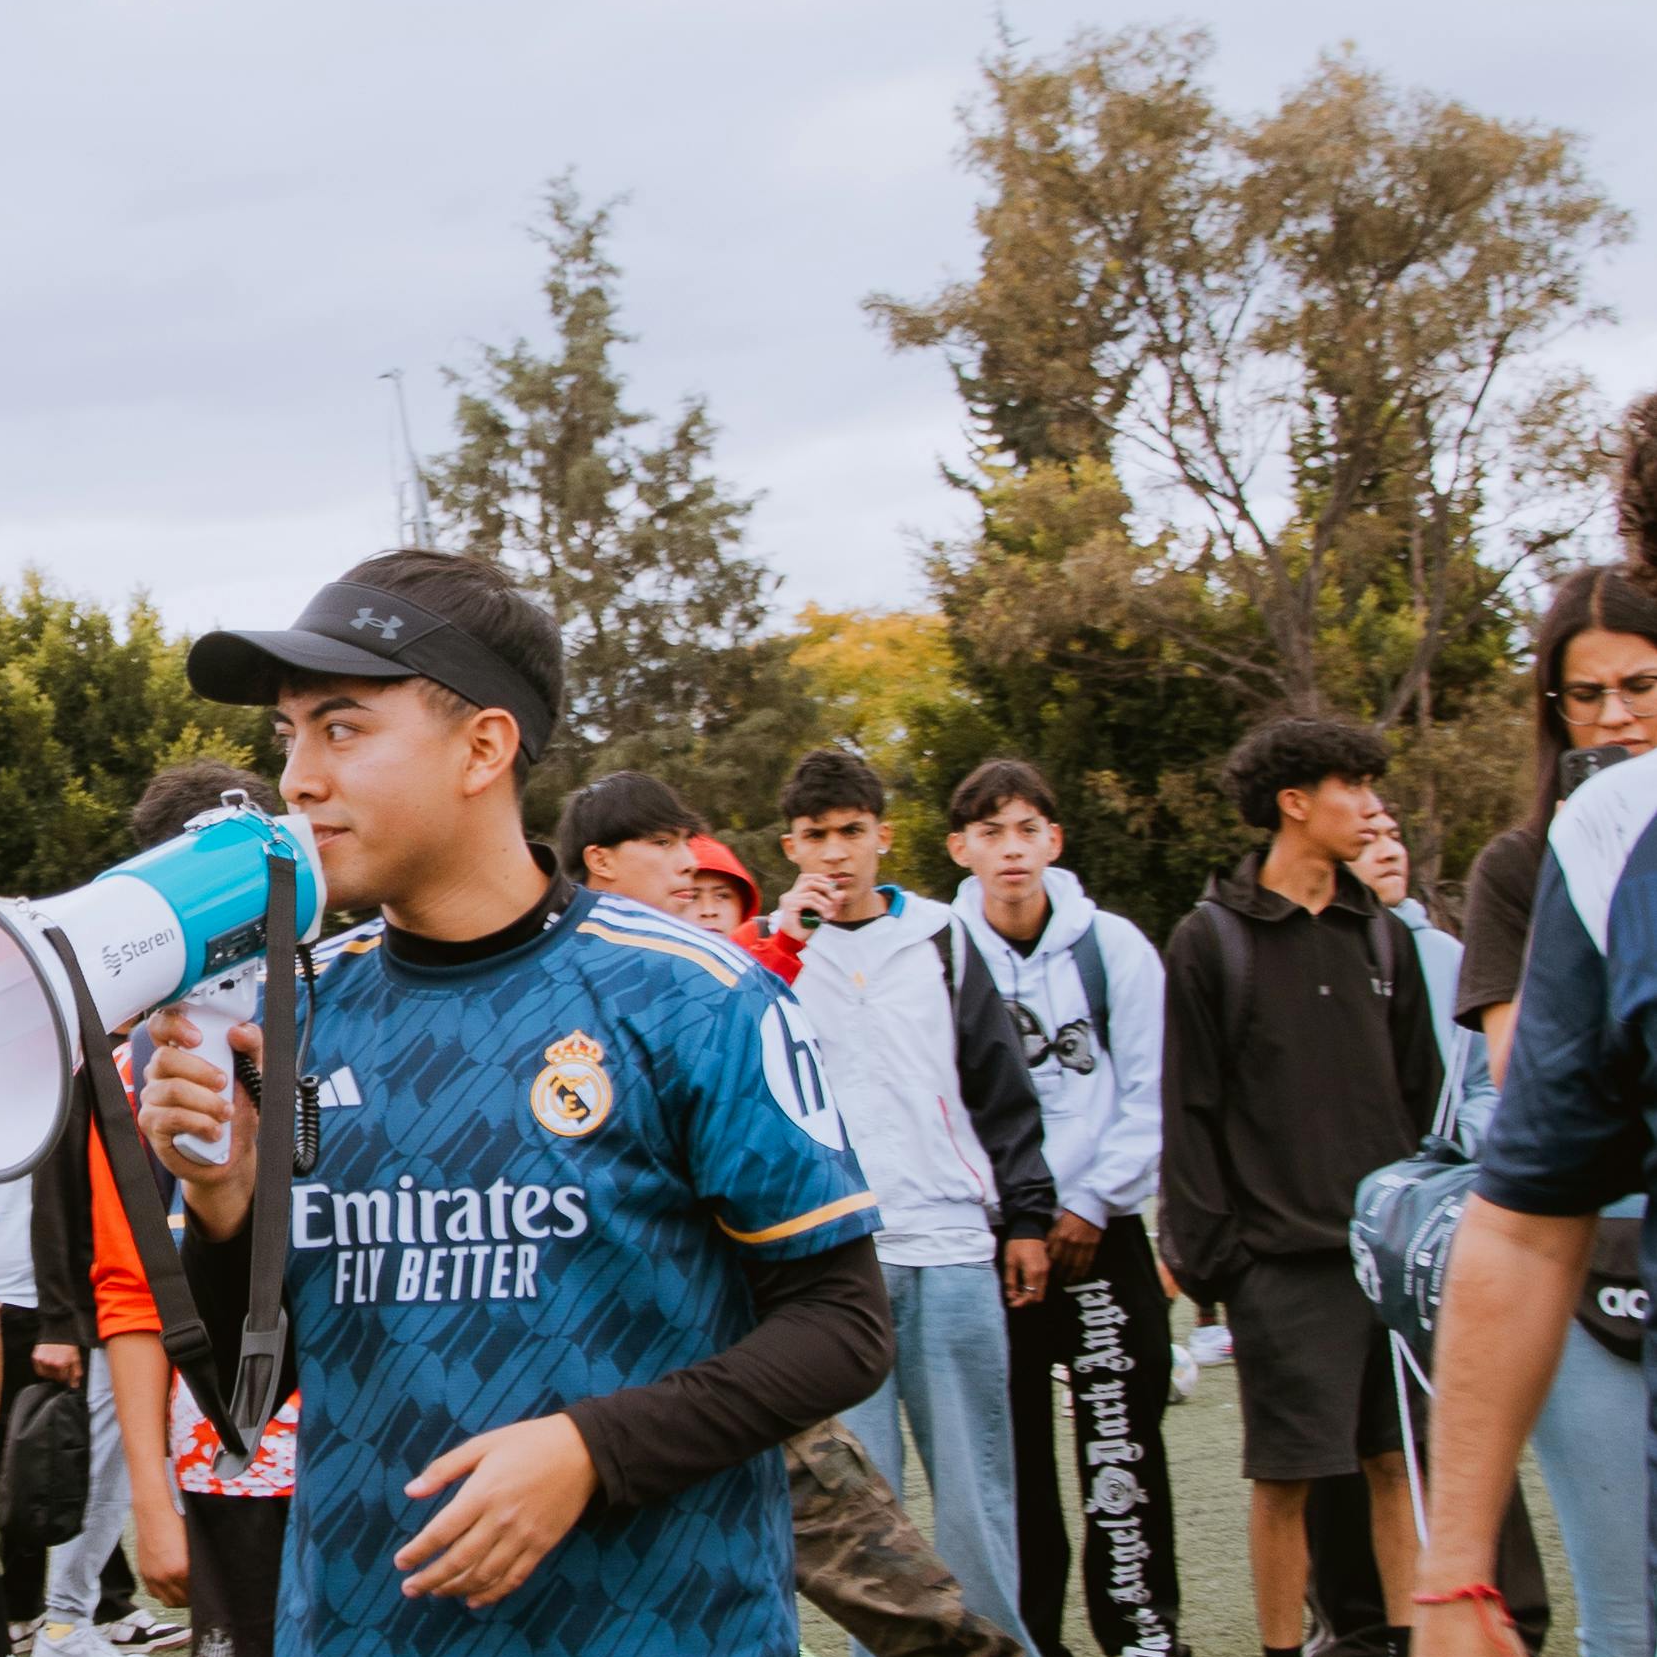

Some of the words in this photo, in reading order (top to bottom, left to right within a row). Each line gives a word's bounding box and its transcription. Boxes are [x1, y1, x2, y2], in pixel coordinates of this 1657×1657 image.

[121, 928, 176, 964] Steren
[291, 1174, 588, 1249] Emirates
[334, 1247, 385, 1304] FLY
[395, 1243, 539, 1302] BETTER
[1063, 1278, 1136, 1373] Angel
[1078, 1379, 1144, 1466] Dark
[1096, 1515, 1153, 1605] Angel
